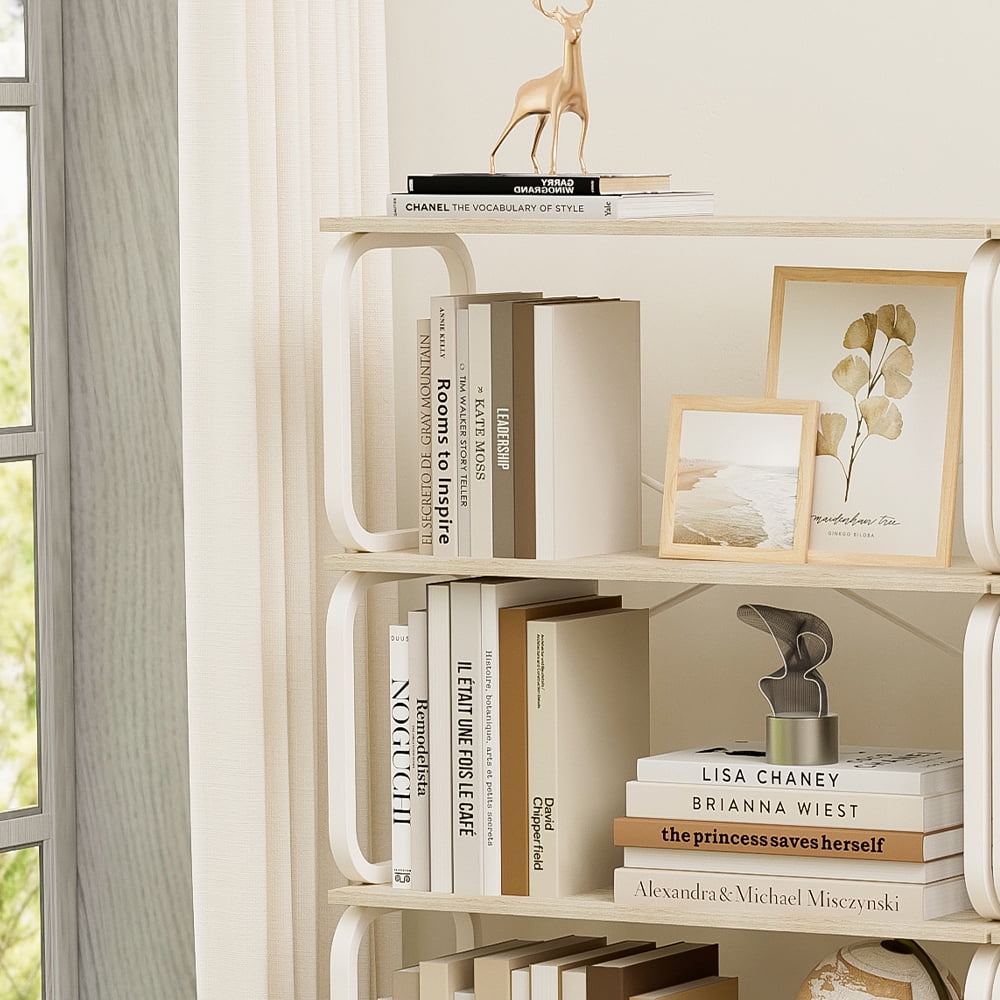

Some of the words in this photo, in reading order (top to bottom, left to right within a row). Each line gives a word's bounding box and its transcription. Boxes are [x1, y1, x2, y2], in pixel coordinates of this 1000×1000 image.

[406, 203, 450, 212] CHANEL
[453, 204, 470, 212] THE
[472, 204, 537, 212] VOCABULARY
[539, 204, 553, 212] OF
[604, 201, 612, 216] Yale
[437, 379, 450, 444] Rooms
[475, 399, 485, 436] KATE
[497, 407, 509, 470] LEADERSHIP
[438, 450, 450, 471] to
[476, 440, 485, 481] MOSS
[435, 478, 452, 545] Inspire
[877, 516, 900, 526] tree
[392, 680, 411, 825] NOGUCHI
[416, 698, 428, 796] Remodelista
[703, 767, 746, 783] LISA
[757, 770, 840, 787] CHANEY
[545, 797, 554, 831] David
[693, 797, 786, 815] BRIANNA
[797, 802, 858, 818] WIEST
[533, 797, 544, 870] Chipperfield
[661, 828, 690, 842] the
[693, 830, 769, 848] princess
[770, 835, 818, 849] saves
[821, 836, 885, 853] herself
[634, 881, 716, 901] Alexandra
[719, 886, 733, 902] &
[736, 886, 800, 906] Michael
[807, 890, 899, 915] Misczynski
